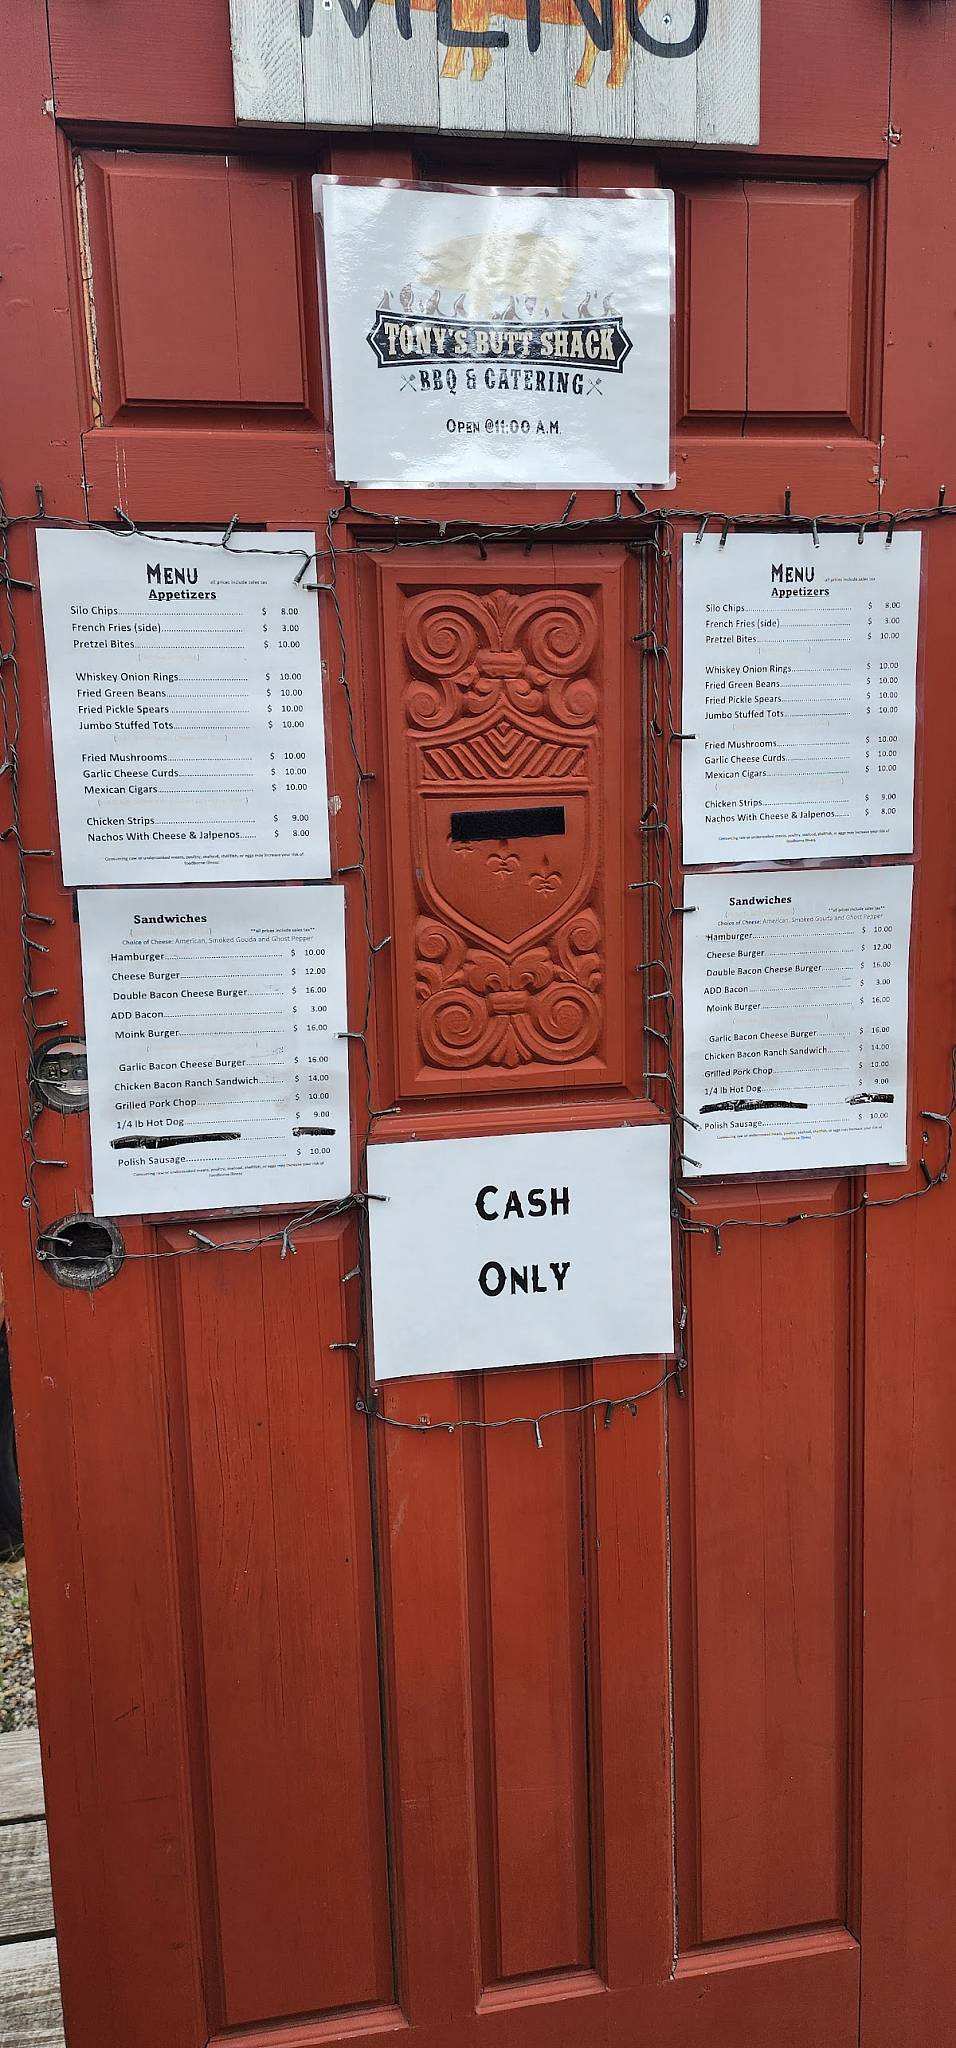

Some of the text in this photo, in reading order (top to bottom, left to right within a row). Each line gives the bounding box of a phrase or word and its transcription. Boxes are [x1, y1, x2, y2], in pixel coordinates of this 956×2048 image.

[384, 322, 617, 360] TONY'S BUTT SHACK
[419, 369, 457, 395] BBQ
[485, 368, 584, 395] CATERING
[149, 589, 216, 601] Appetizers
[772, 587, 829, 598] Appetizers
[71, 606, 88, 614] Silo
[706, 604, 720, 612] Silo
[72, 623, 105, 631] French
[74, 640, 107, 648] Pretzel
[706, 666, 740, 675] Whiskey
[743, 665, 767, 673] Onion
[76, 673, 117, 682] Whiskey
[121, 673, 149, 681] Onion
[78, 689, 96, 697] Fried
[97, 689, 134, 697] Green
[79, 705, 102, 713] Fried
[106, 705, 134, 713] Pickle
[115, 721, 149, 729] Stuffed
[82, 754, 106, 762] Fried
[83, 770, 111, 778] Garlic
[114, 769, 148, 777] Cheese
[85, 786, 125, 794] Mexican
[87, 817, 124, 825] Chicken
[88, 833, 123, 841] Nachos
[126, 832, 149, 840] With
[153, 832, 186, 840] Cheese
[730, 896, 791, 906] Sandwiches
[134, 914, 207, 924] Sandwiches
[707, 968, 735, 976] Double
[113, 992, 146, 1000] Double
[115, 1030, 145, 1039] Moink
[705, 1052, 734, 1060] Chicken
[764, 1048, 787, 1056] Ranch
[119, 1063, 146, 1071] Garlic
[185, 1079, 212, 1087] Ranch
[705, 1087, 717, 1096] 1/4
[115, 1101, 146, 1109] Grilled
[117, 1120, 132, 1129] 1/4
[119, 1158, 145, 1166] Polish
